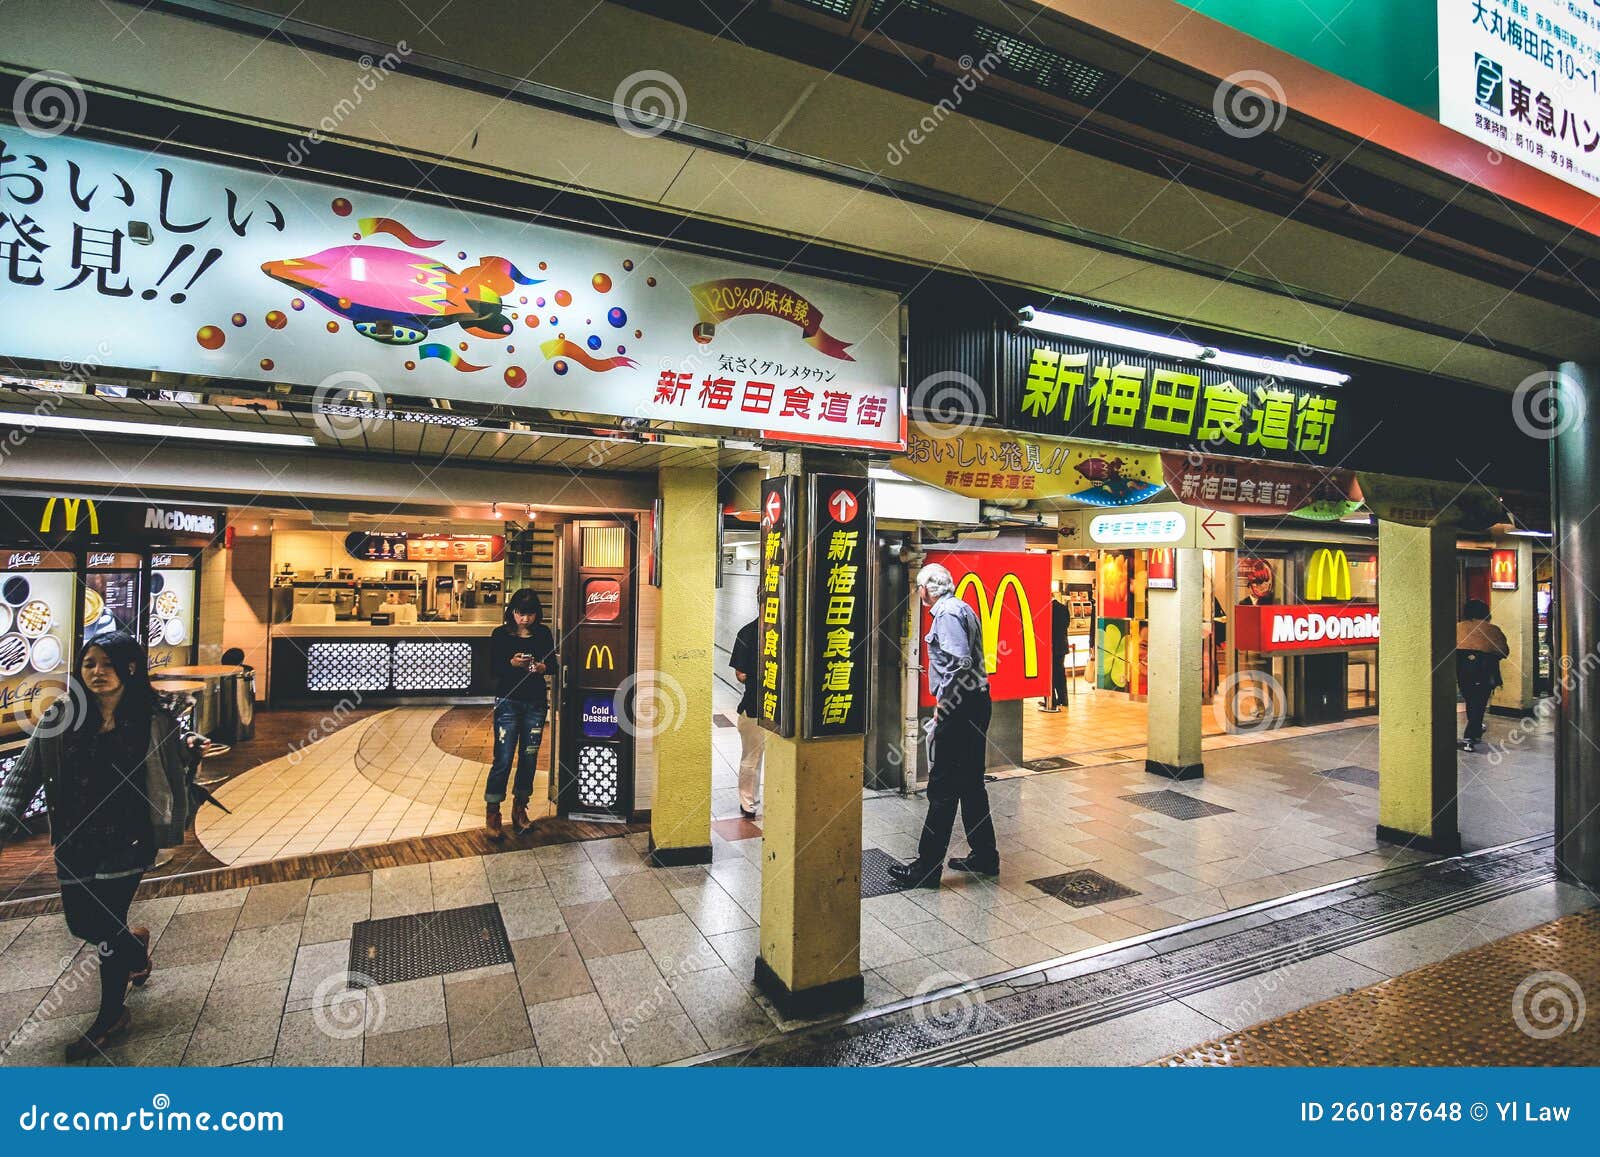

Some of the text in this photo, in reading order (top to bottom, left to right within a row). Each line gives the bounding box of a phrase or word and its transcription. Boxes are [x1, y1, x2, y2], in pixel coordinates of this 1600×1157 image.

[718, 353, 838, 383] 気さくグルメタウン
[653, 369, 888, 428] 新梅田食道街
[1021, 346, 1337, 455] 新梅田食道街
[944, 469, 1036, 491] 新梅田食道街
[1181, 472, 1292, 506] 新梅田食道街
[763, 530, 781, 722] 新梅田食道街
[821, 529, 858, 725] 新梅田食道街
[583, 713, 618, 723] Desserts
[591, 705, 609, 715] Cold
